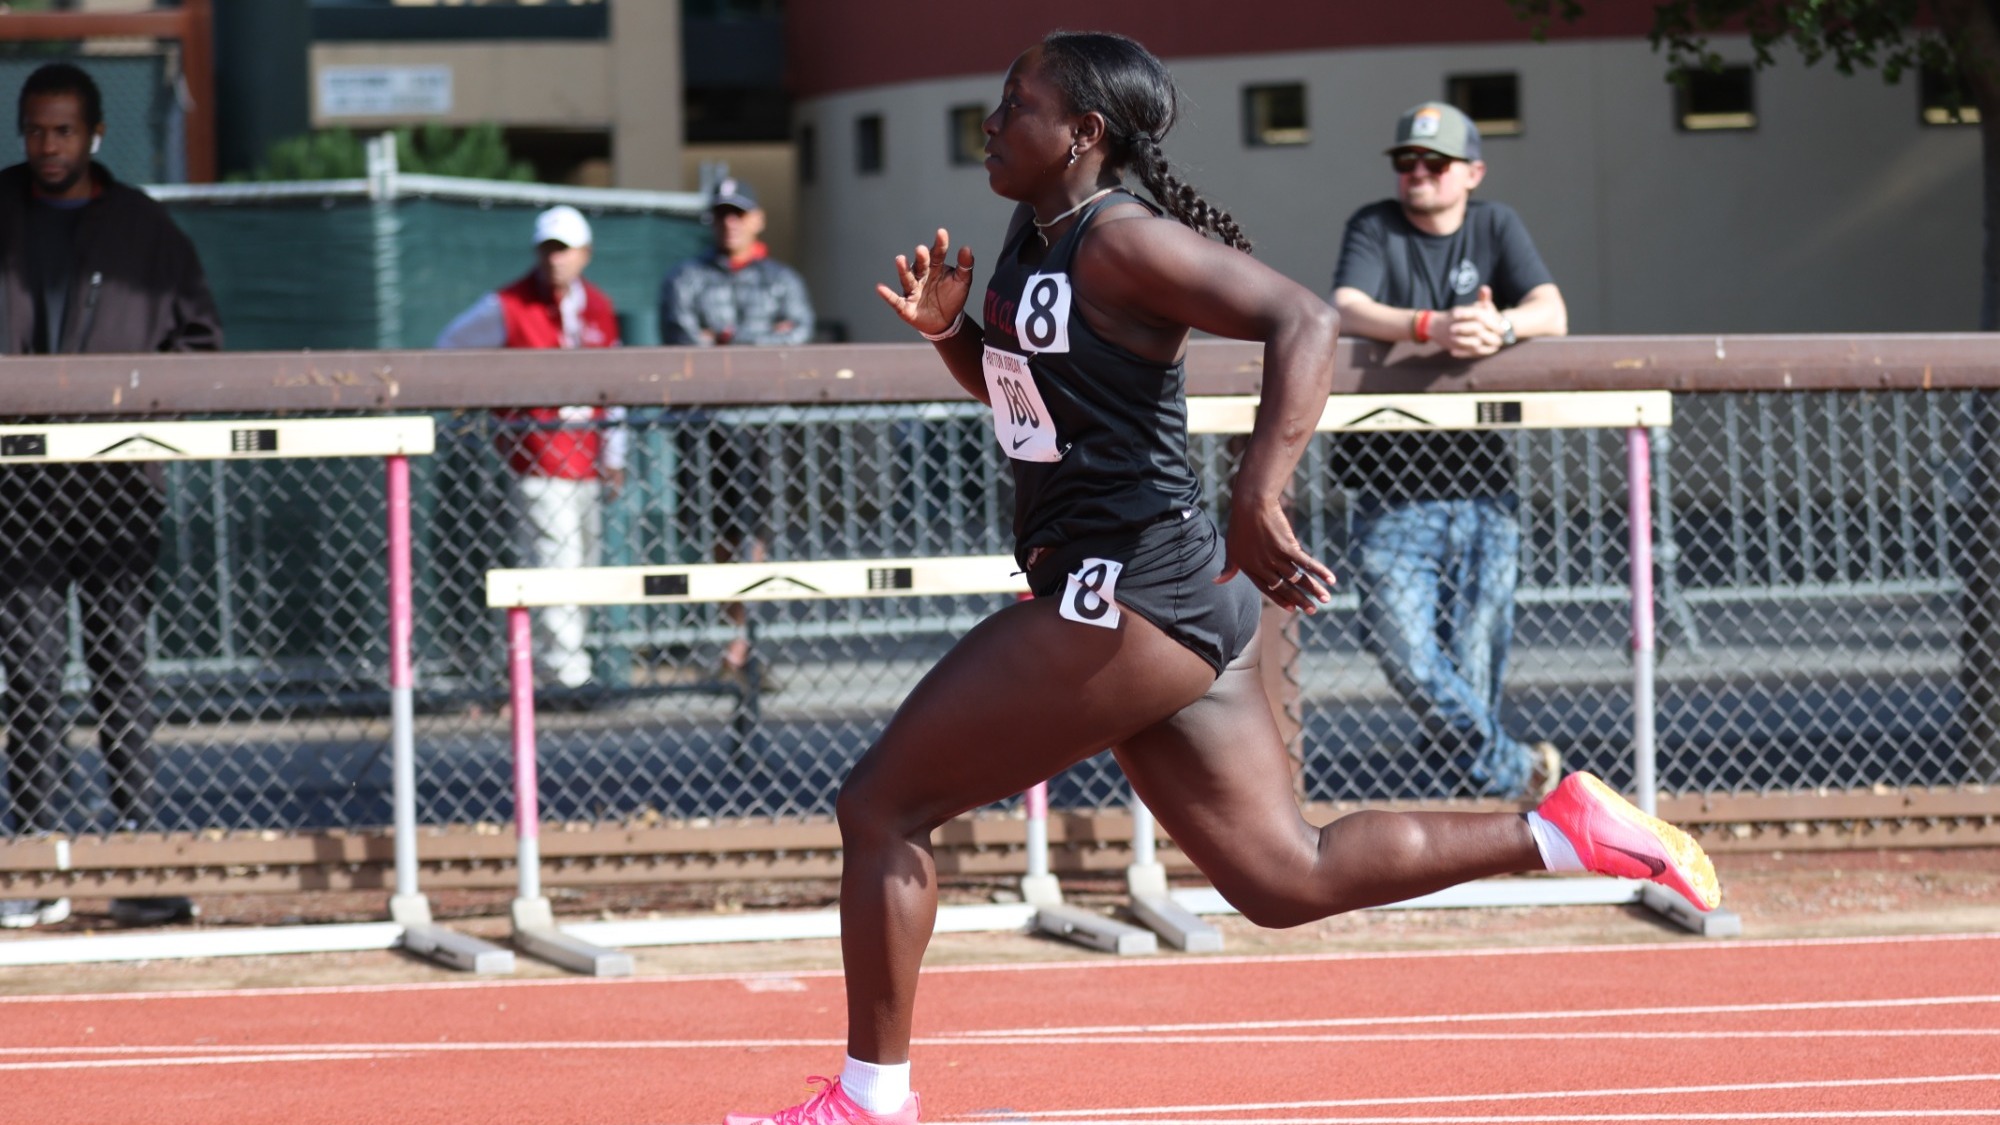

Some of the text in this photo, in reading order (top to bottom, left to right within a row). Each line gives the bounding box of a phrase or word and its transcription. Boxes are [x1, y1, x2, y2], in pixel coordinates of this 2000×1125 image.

[1025, 278, 1058, 349] 8
[986, 349, 1022, 374] PAYTON JORDAN
[997, 375, 1039, 429] 180
[1074, 563, 1110, 620] 8
